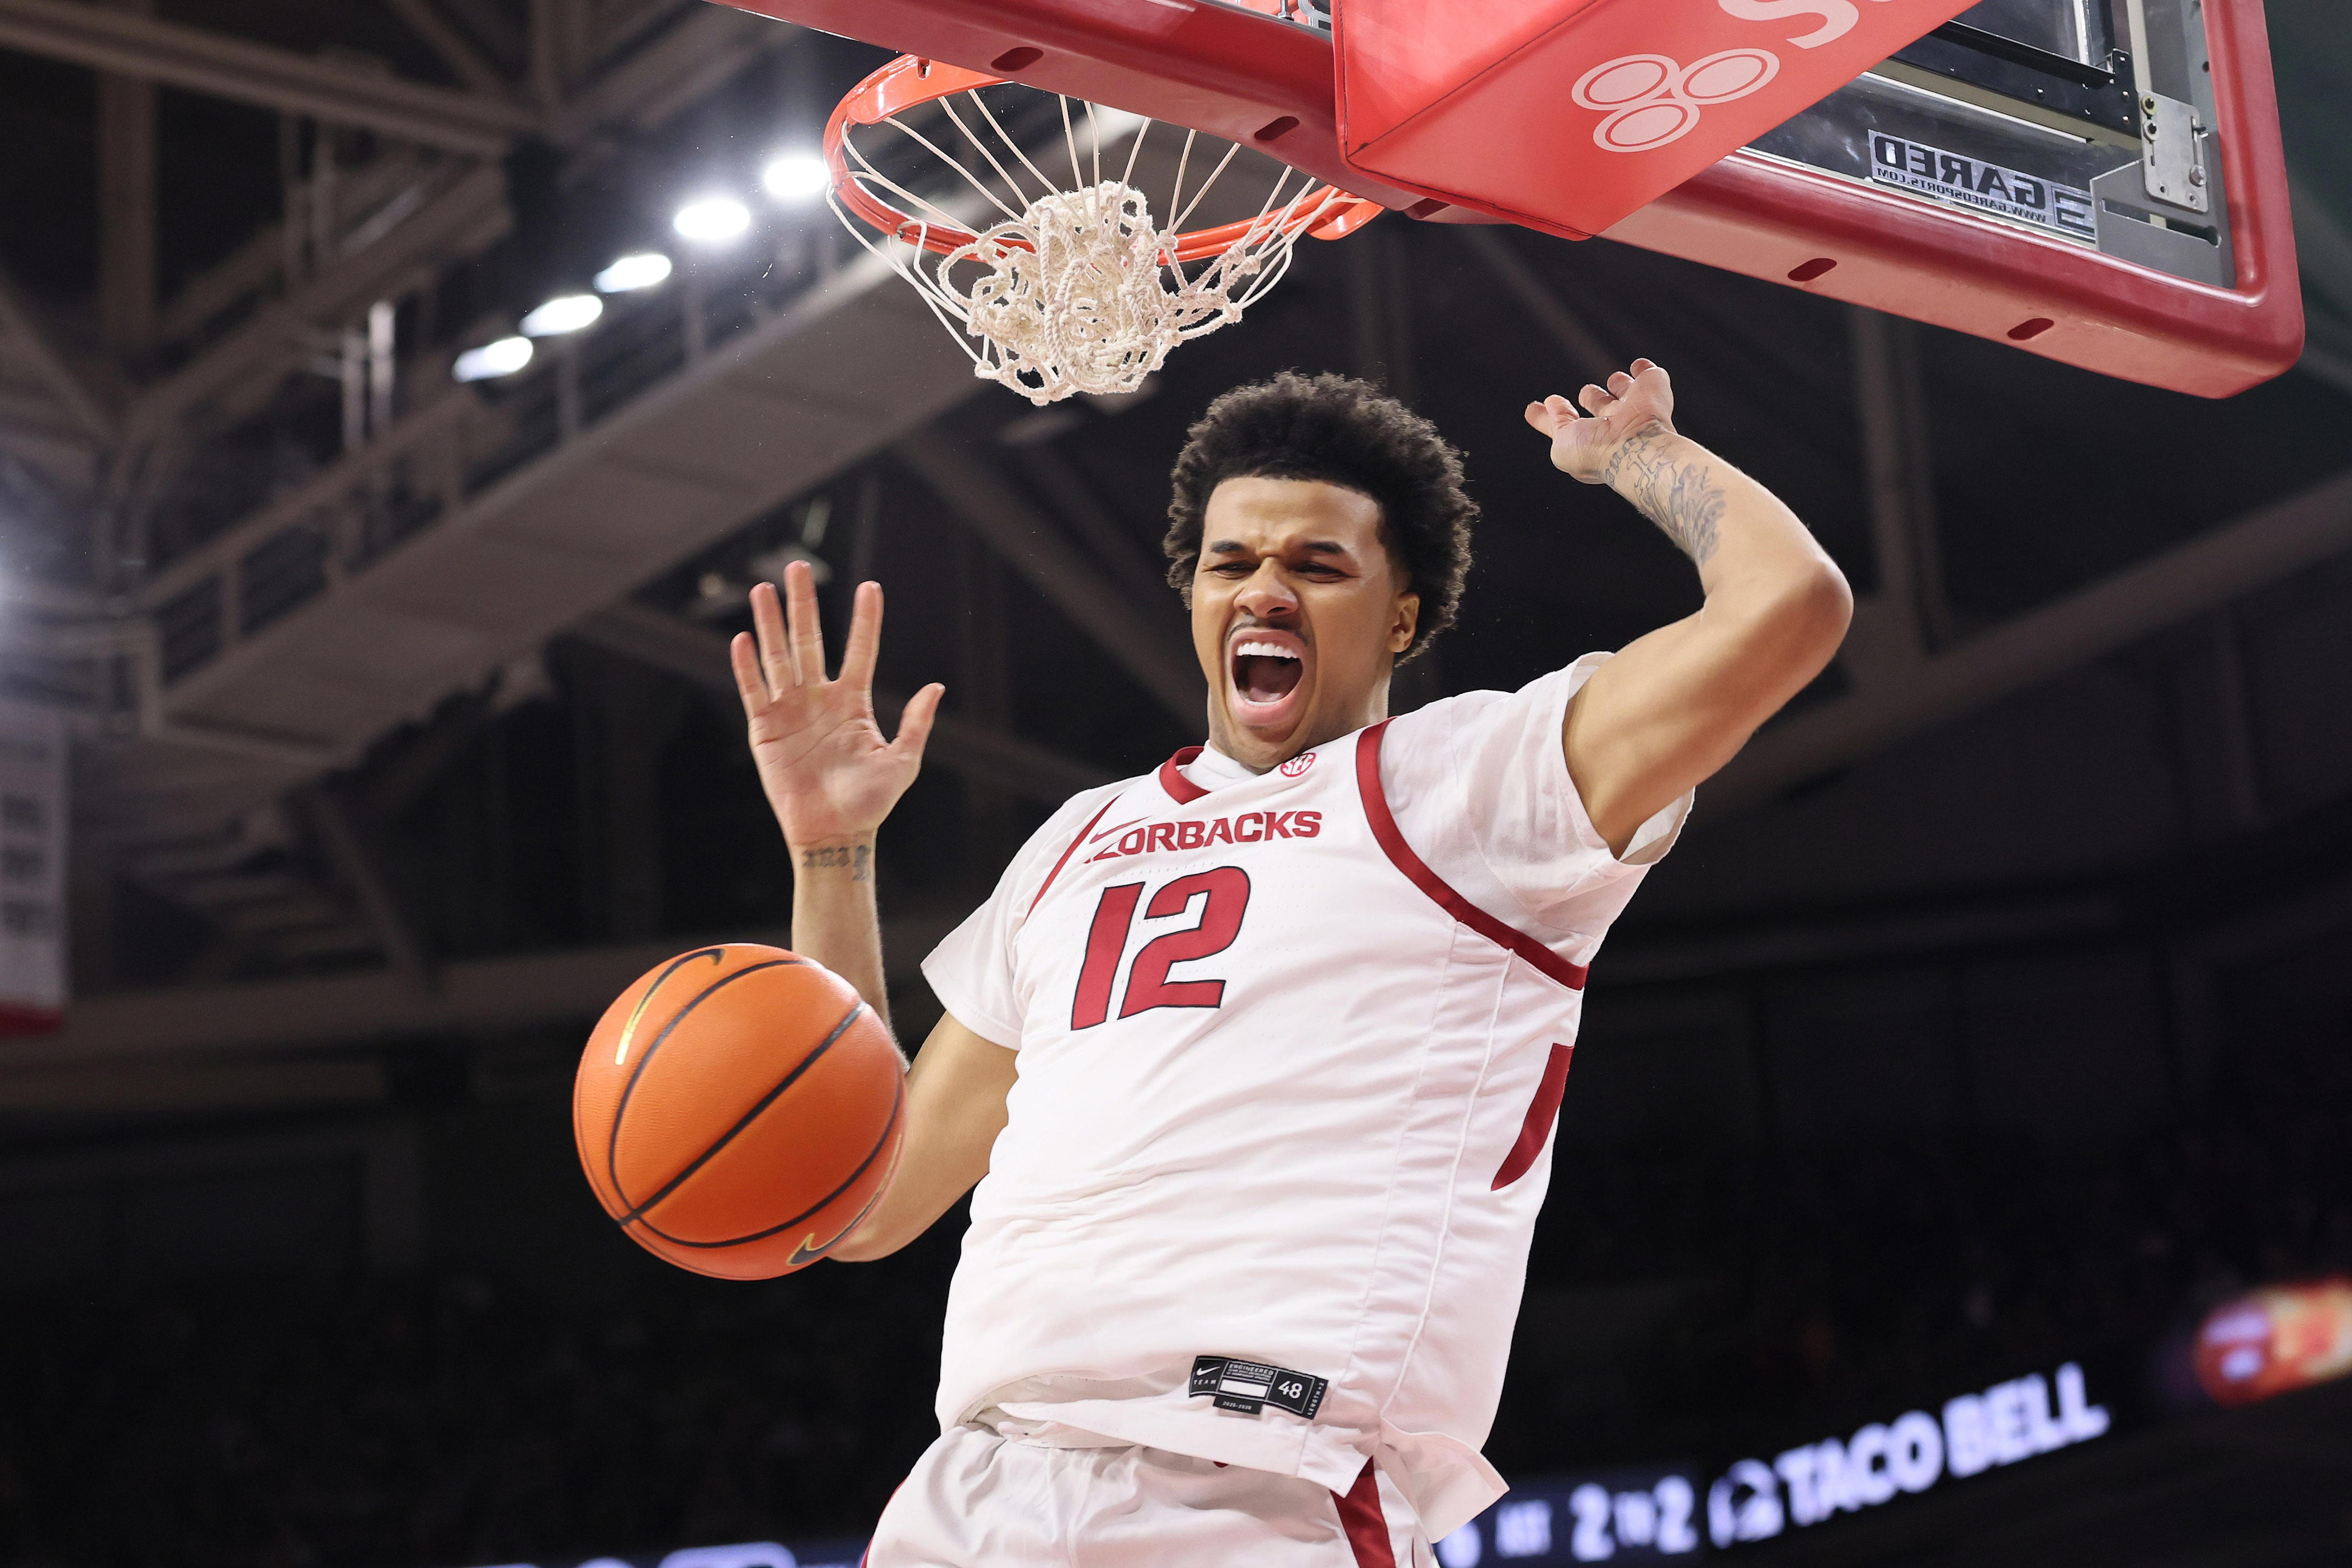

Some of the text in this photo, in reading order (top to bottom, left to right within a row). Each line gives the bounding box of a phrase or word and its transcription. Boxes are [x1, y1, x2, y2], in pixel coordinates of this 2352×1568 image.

[1070, 866, 1251, 1031] 12
[1278, 1380, 1303, 1399] 48
[1772, 1409, 1945, 1527] TACO
[1942, 1361, 2112, 1479] BELL
